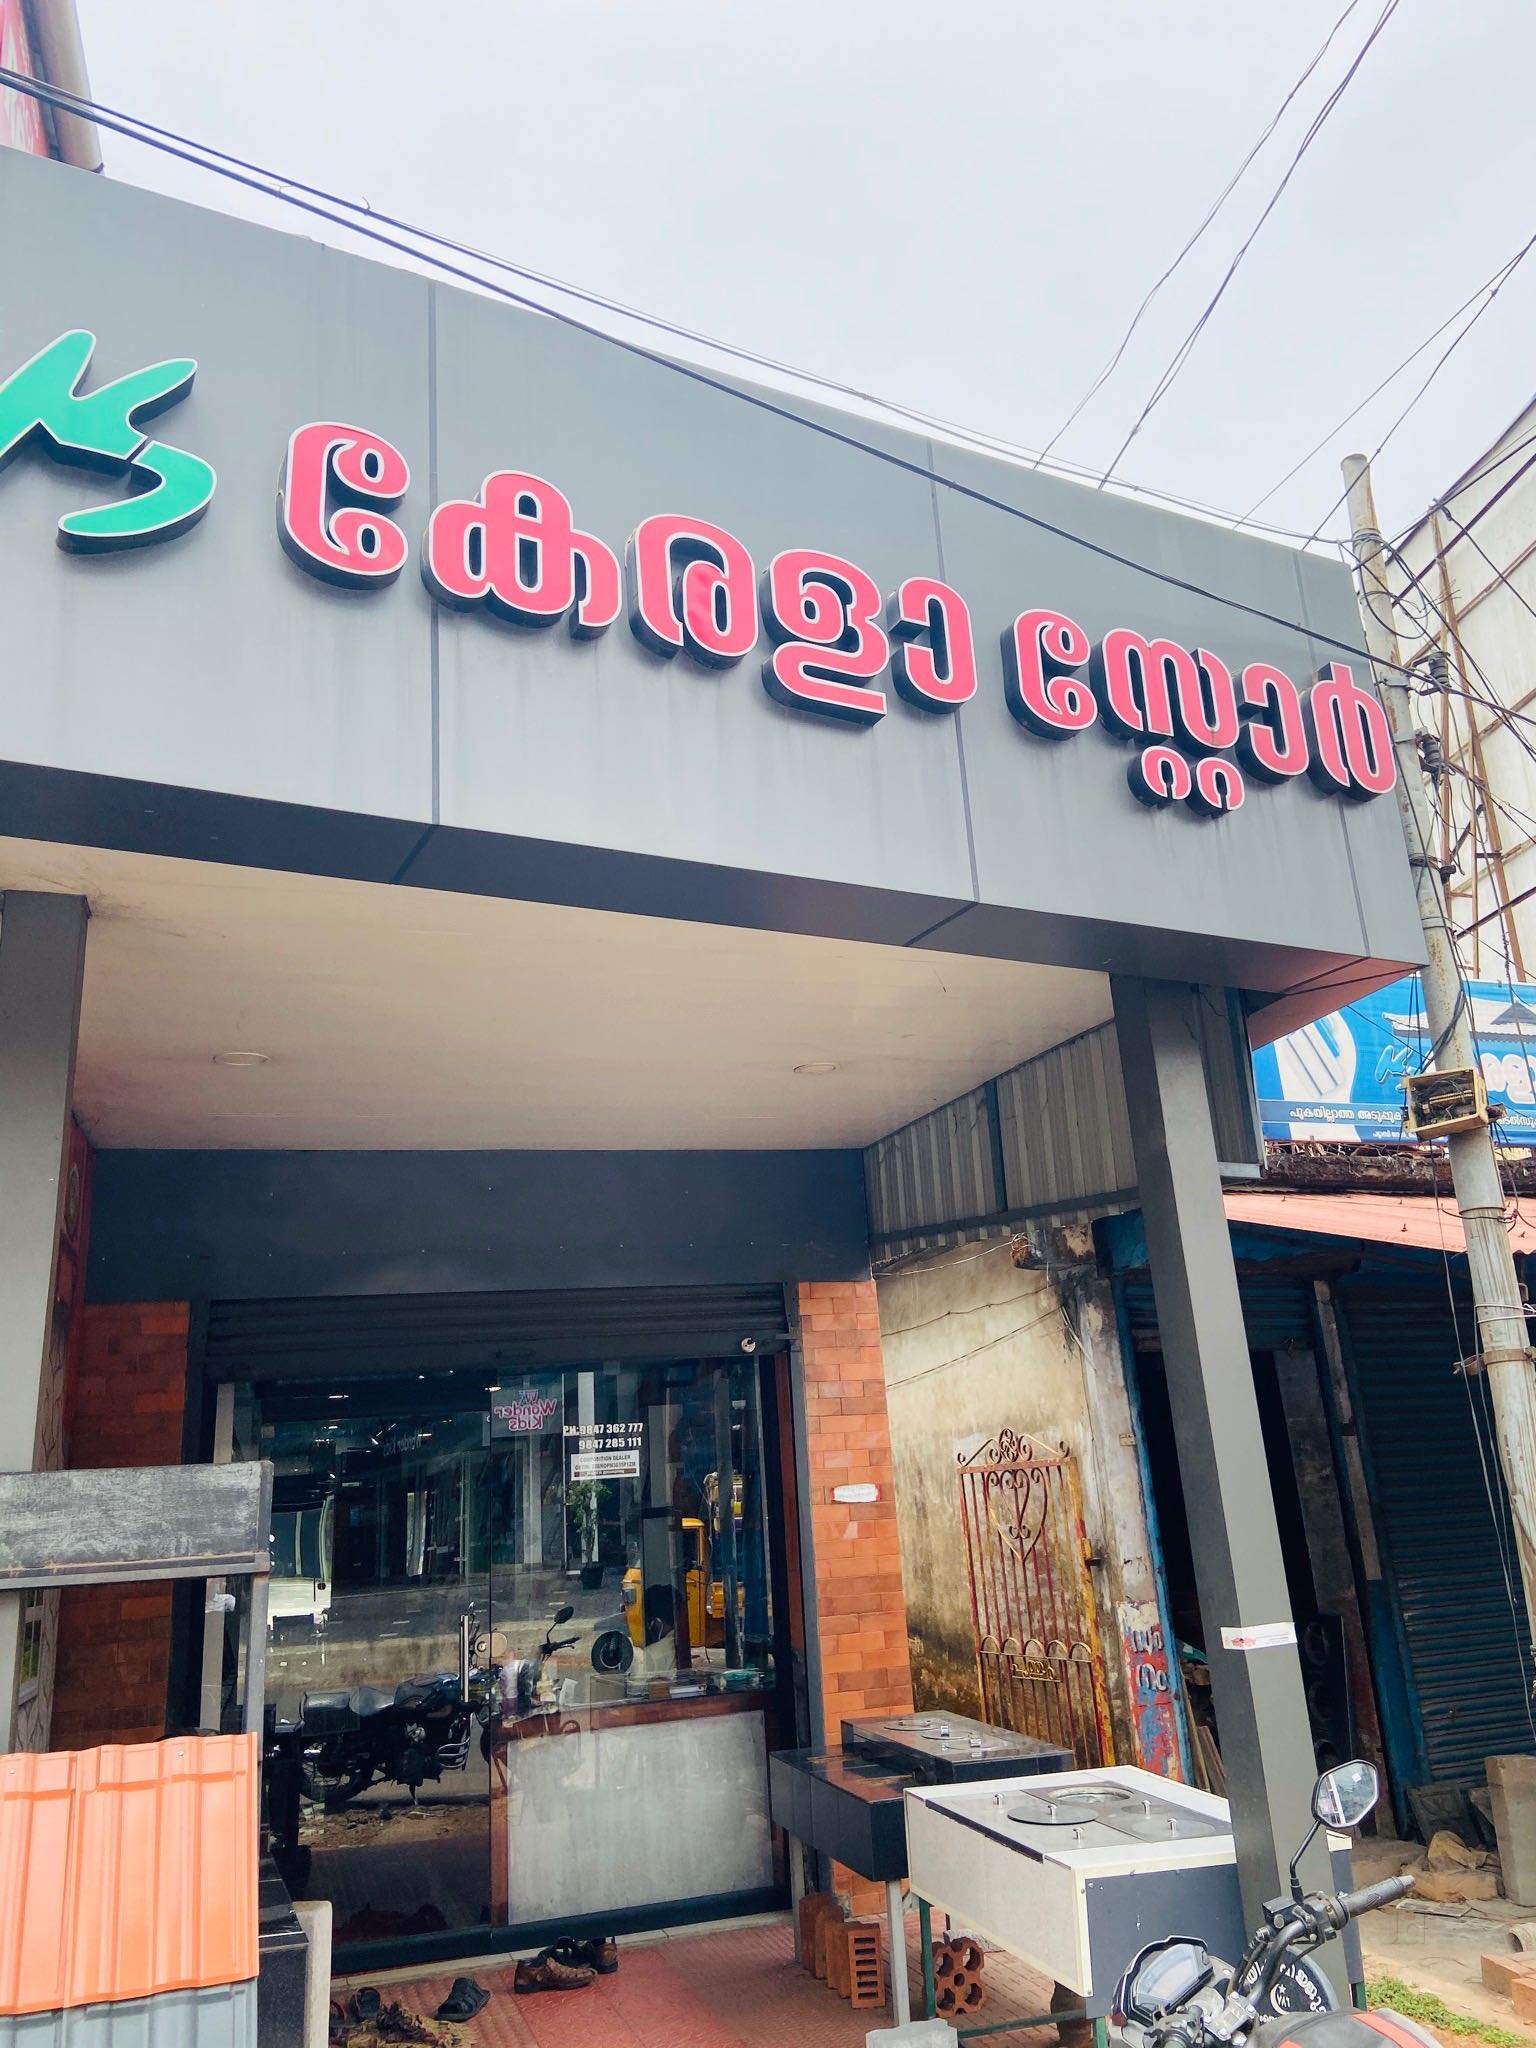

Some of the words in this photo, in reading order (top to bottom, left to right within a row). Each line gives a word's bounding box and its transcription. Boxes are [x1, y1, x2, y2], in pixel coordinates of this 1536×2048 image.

[285, 421, 979, 717] കേരളാ
[1013, 608, 1398, 811] സ്റ്റോർ
[606, 1423, 626, 1434] 362
[627, 1422, 644, 1433] 777
[579, 1439, 604, 1450] 9847
[605, 1437, 625, 1448] 285
[626, 1436, 642, 1447] 111
